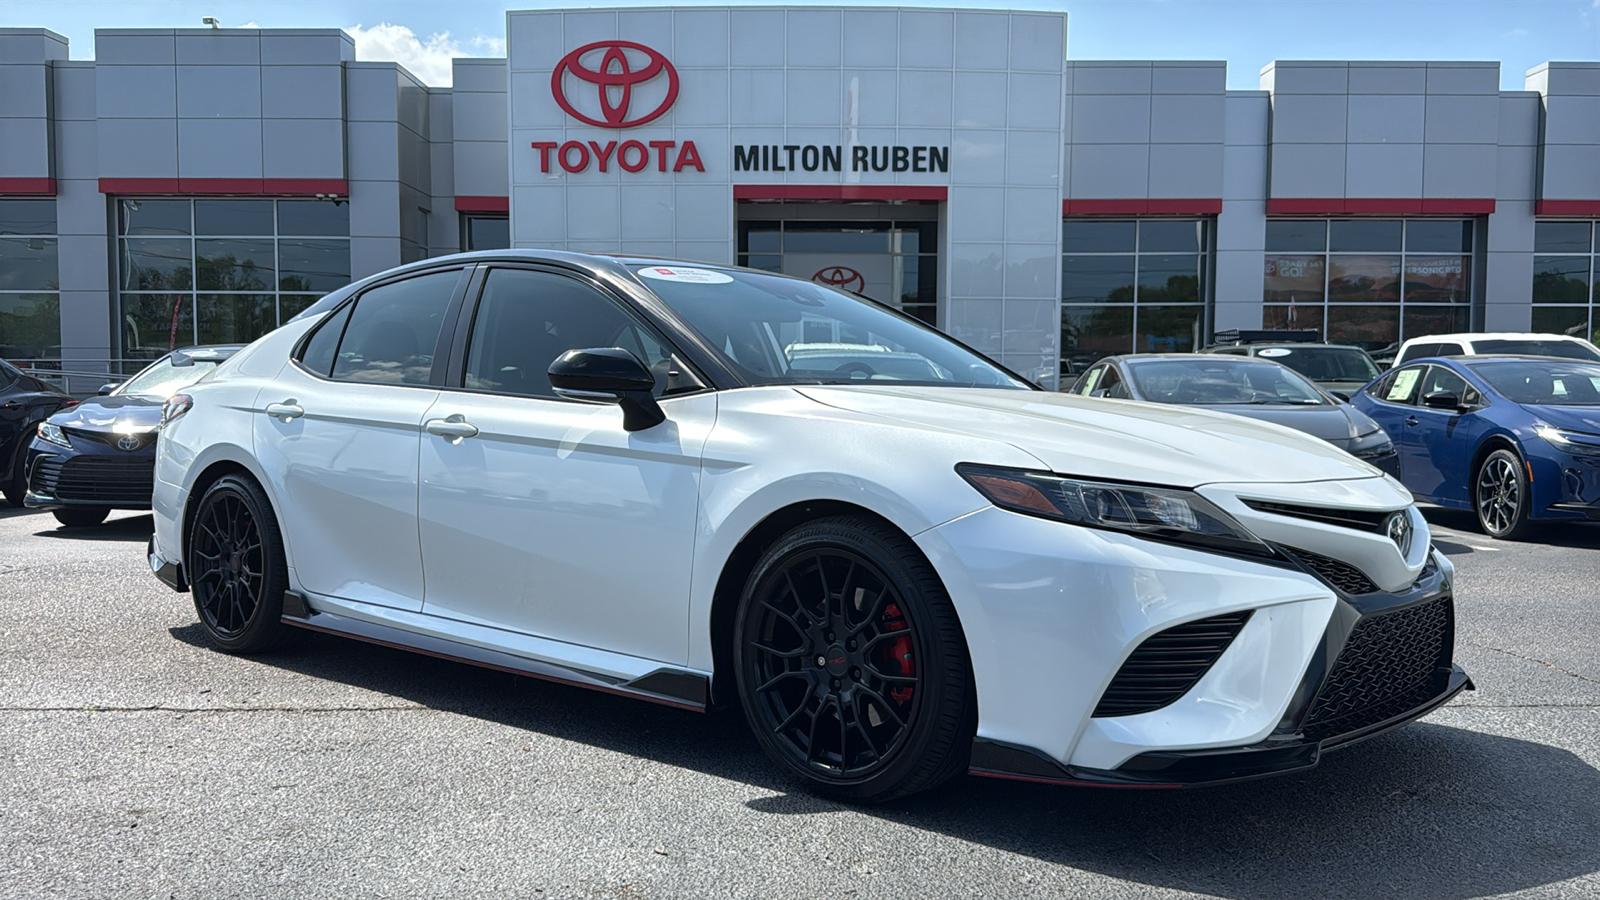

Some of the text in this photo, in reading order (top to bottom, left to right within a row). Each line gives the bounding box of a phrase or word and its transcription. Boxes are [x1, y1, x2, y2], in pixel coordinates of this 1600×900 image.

[531, 140, 705, 173] TOYOTA
[734, 145, 949, 173] MILTON RUBEN
